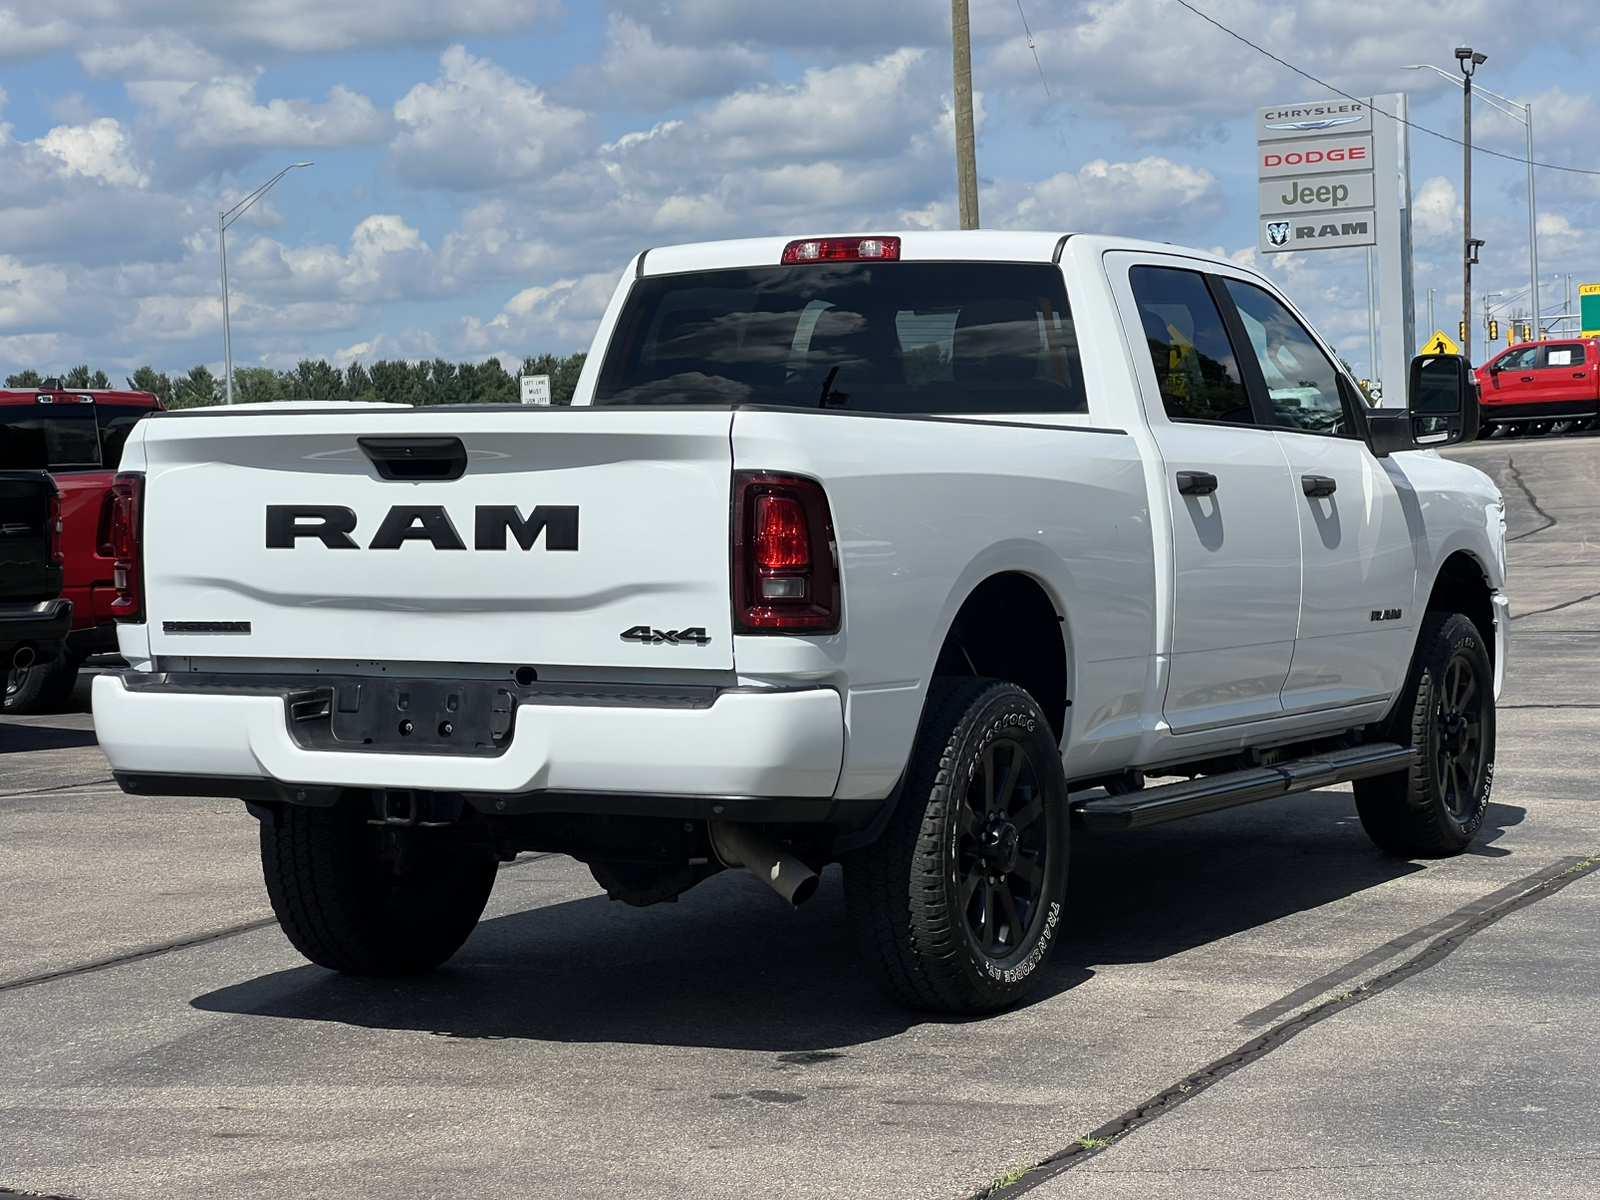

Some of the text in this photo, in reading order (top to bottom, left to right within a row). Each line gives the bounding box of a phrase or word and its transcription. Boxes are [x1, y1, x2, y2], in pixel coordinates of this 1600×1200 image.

[1264, 104, 1362, 120] CHRYSLER
[1264, 146, 1366, 167] DODGE
[1281, 181, 1349, 207] Jeep
[1295, 221, 1368, 239] RAM
[265, 504, 580, 551] RAM
[1370, 608, 1403, 622] RAM
[620, 625, 712, 646] 4x4
